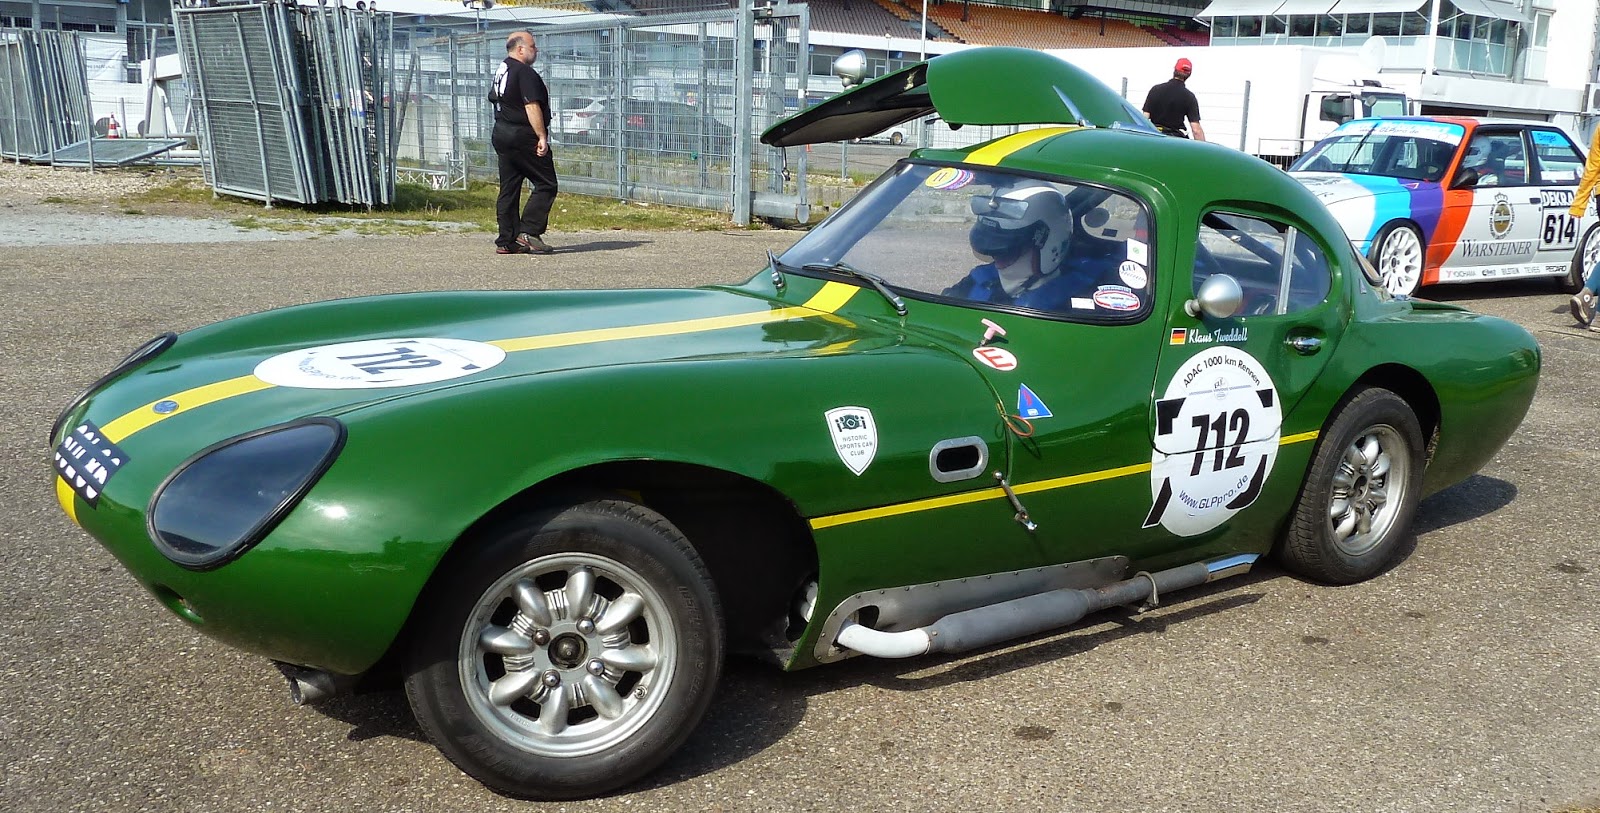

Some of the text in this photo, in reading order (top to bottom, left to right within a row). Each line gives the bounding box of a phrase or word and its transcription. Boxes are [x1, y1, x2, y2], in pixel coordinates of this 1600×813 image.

[1541, 191, 1574, 207] DEKRA
[1543, 214, 1576, 244] 614
[1462, 239, 1532, 257] WARSTEINER
[1188, 327, 1248, 343] Klaus Tweddell
[336, 346, 442, 375] 712
[975, 348, 1014, 369] E
[1183, 363, 1203, 388] ADAC
[1203, 355, 1223, 369] 1000
[1224, 354, 1237, 366] km
[1237, 359, 1261, 387] Rennen
[840, 442, 862, 450] SPORTS
[1190, 407, 1250, 476] 712
[850, 449, 865, 457] CLUB
[1179, 475, 1248, 509] www.GLPpro.de
